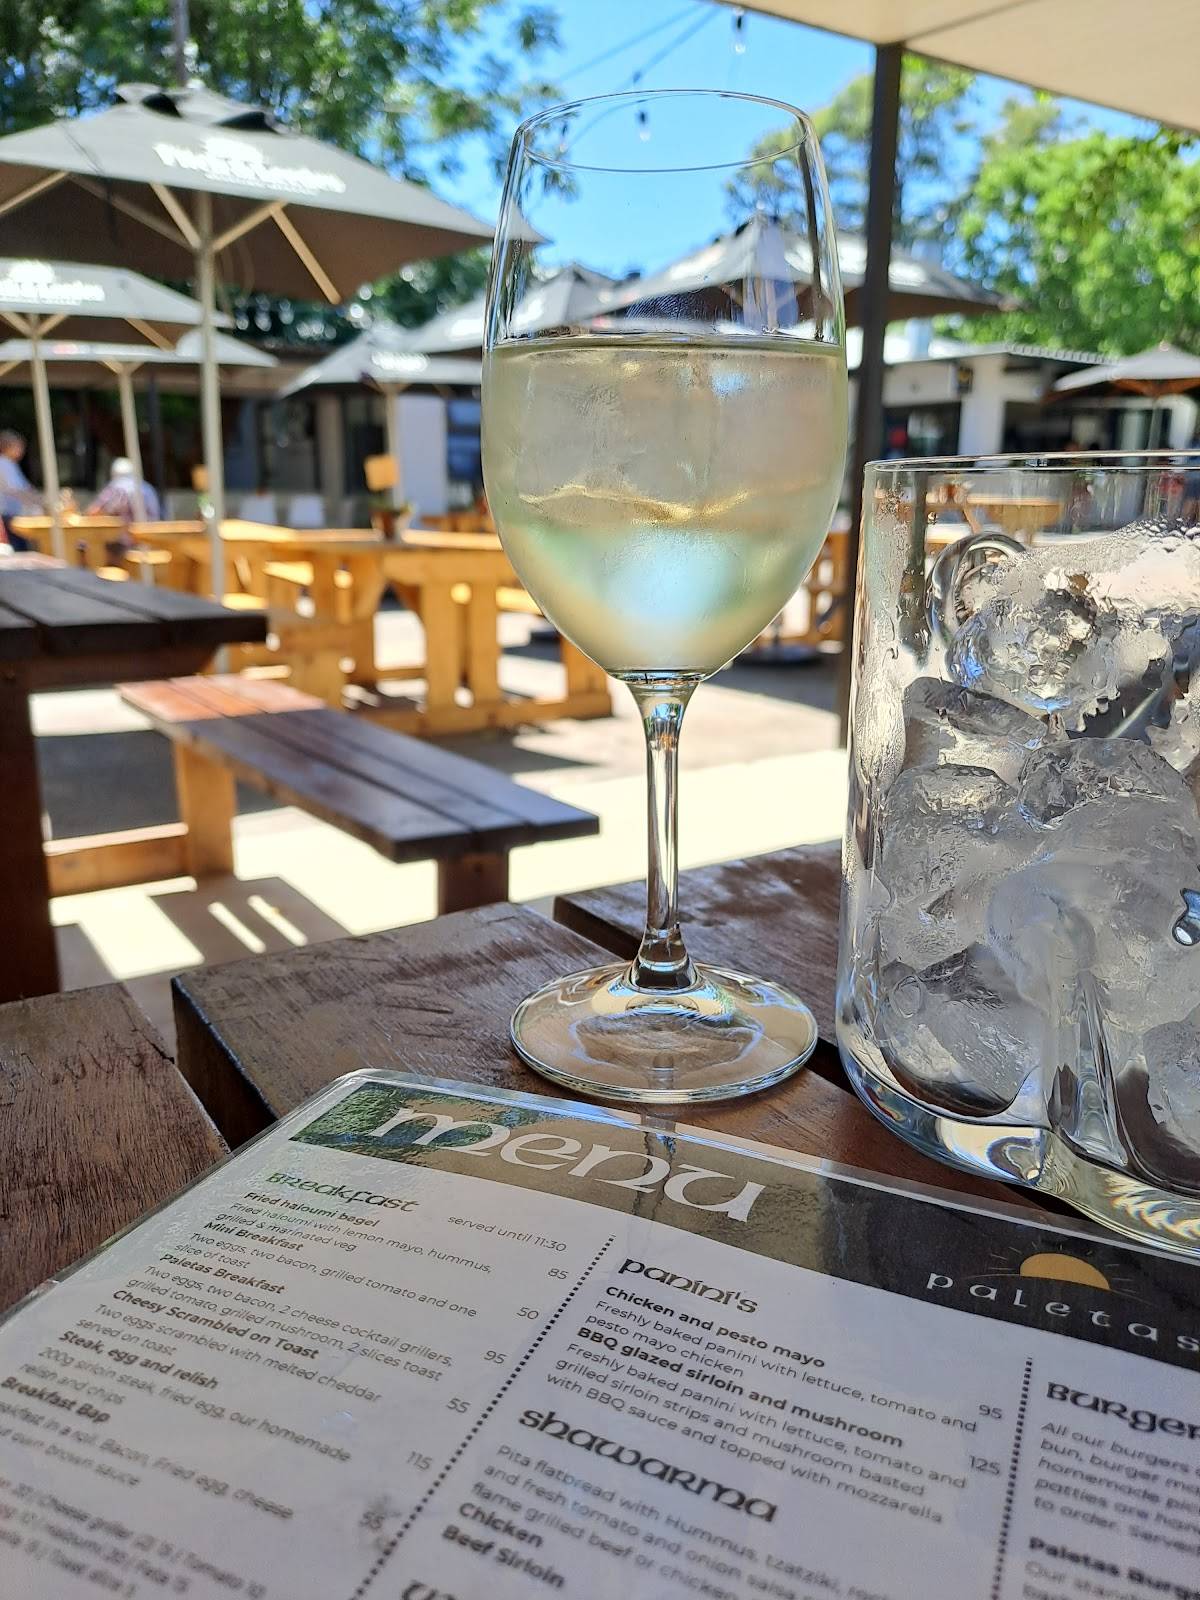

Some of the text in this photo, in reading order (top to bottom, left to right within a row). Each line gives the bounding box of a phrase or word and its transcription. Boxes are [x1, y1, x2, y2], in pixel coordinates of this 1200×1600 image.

[370, 1106, 766, 1223] menu
[203, 1221, 304, 1251] Mini Breakfast
[215, 1213, 357, 1252] grilled & marinated veg
[230, 1202, 491, 1273] Fried haloumi with lemon mayo, hummus,
[243, 1192, 380, 1227] Fried haloumi bagel
[447, 1213, 567, 1253] served until 11:30
[159, 1253, 285, 1294] Paletas Breakfast
[174, 1244, 251, 1269] slice of toast
[190, 1232, 215, 1245] Two
[250, 1248, 276, 1260] two
[275, 1254, 317, 1273] bacon,
[319, 1268, 366, 1284] grilled
[365, 1279, 417, 1299] tomato
[418, 1294, 449, 1308] and
[448, 1304, 477, 1317] one
[547, 1268, 569, 1280] 85
[617, 1257, 759, 1315] panini's
[76, 1319, 177, 1356] served on toast
[113, 1290, 319, 1359] Cheesy Scrambled on Toast
[125, 1279, 443, 1381] grilled tomato, grilled mushroom, 2 slices toast
[144, 1265, 452, 1367] Two eggs, two bacon, 2 cheese cocktail grillers,
[516, 1306, 539, 1320] 50
[606, 1286, 825, 1368] Chicken and pesto mayo
[925, 1272, 1200, 1352] paletas
[59, 1330, 218, 1389] Steak, egg and relish
[95, 1303, 381, 1402] Two eggs scrambled with melted cheddar
[484, 1350, 507, 1364] 95
[585, 1315, 744, 1377] pesto mayo chicken
[595, 1300, 977, 1433] Freshly baked panini with lettuce, tomato and
[0, 1376, 76, 1410] Breakfast
[446, 1397, 471, 1414] 55
[567, 1343, 967, 1489] Freshly baked panini with lettuce, tomato and
[577, 1327, 903, 1447] BBQ glazed sirloin and mushroom
[979, 1404, 1002, 1420] 95
[159, 1386, 195, 1405] fried
[229, 1412, 257, 1427] our
[258, 1420, 351, 1462] homemade
[547, 1374, 942, 1524] with BBQ sauce and topped with mozzarella
[555, 1360, 925, 1496] grilled sirloin strips and mushroom basted
[1040, 1438, 1083, 1462] bun,
[1041, 1422, 1068, 1436] All
[1071, 1432, 1105, 1448] our
[407, 1451, 433, 1471] 115
[497, 1445, 660, 1520] Pita flatbread with
[519, 1408, 777, 1523] shawarma
[970, 1455, 1000, 1476] 125
[459, 1502, 543, 1548] Chicken
[473, 1482, 522, 1512] flame
[524, 1508, 585, 1539] grilled
[484, 1465, 521, 1486] and
[522, 1478, 567, 1506] fresh
[571, 1501, 640, 1537] tomato
[642, 1533, 682, 1555] and
[442, 1524, 495, 1555] Beef
[496, 1548, 566, 1590] Sirloin
